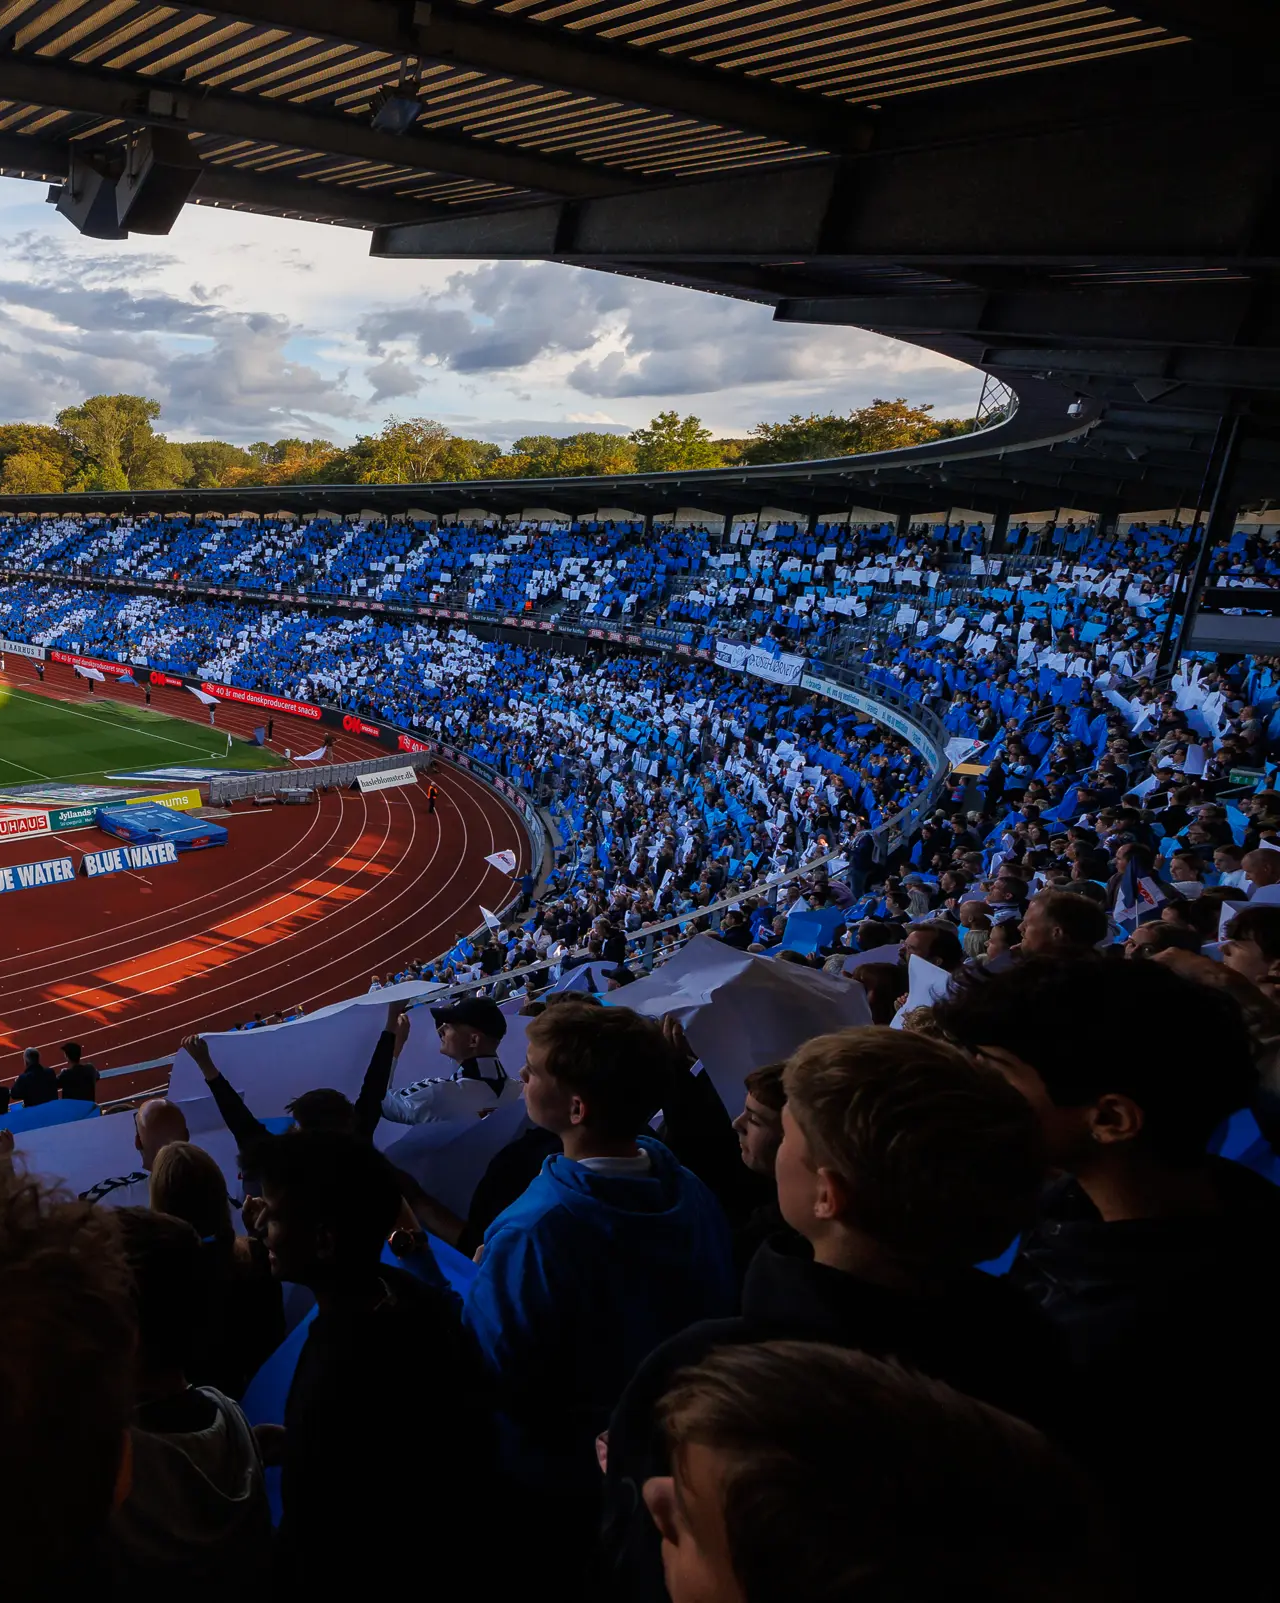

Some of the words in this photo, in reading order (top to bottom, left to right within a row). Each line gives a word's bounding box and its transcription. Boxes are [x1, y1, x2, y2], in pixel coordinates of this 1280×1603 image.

[8, 643, 35, 656] AARHUS
[216, 687, 224, 696] 40
[232, 691, 245, 701] med
[246, 694, 297, 712] danskproduceret
[298, 706, 318, 717] snacks
[17, 859, 74, 887] WATER
[85, 850, 122, 877] BLUE
